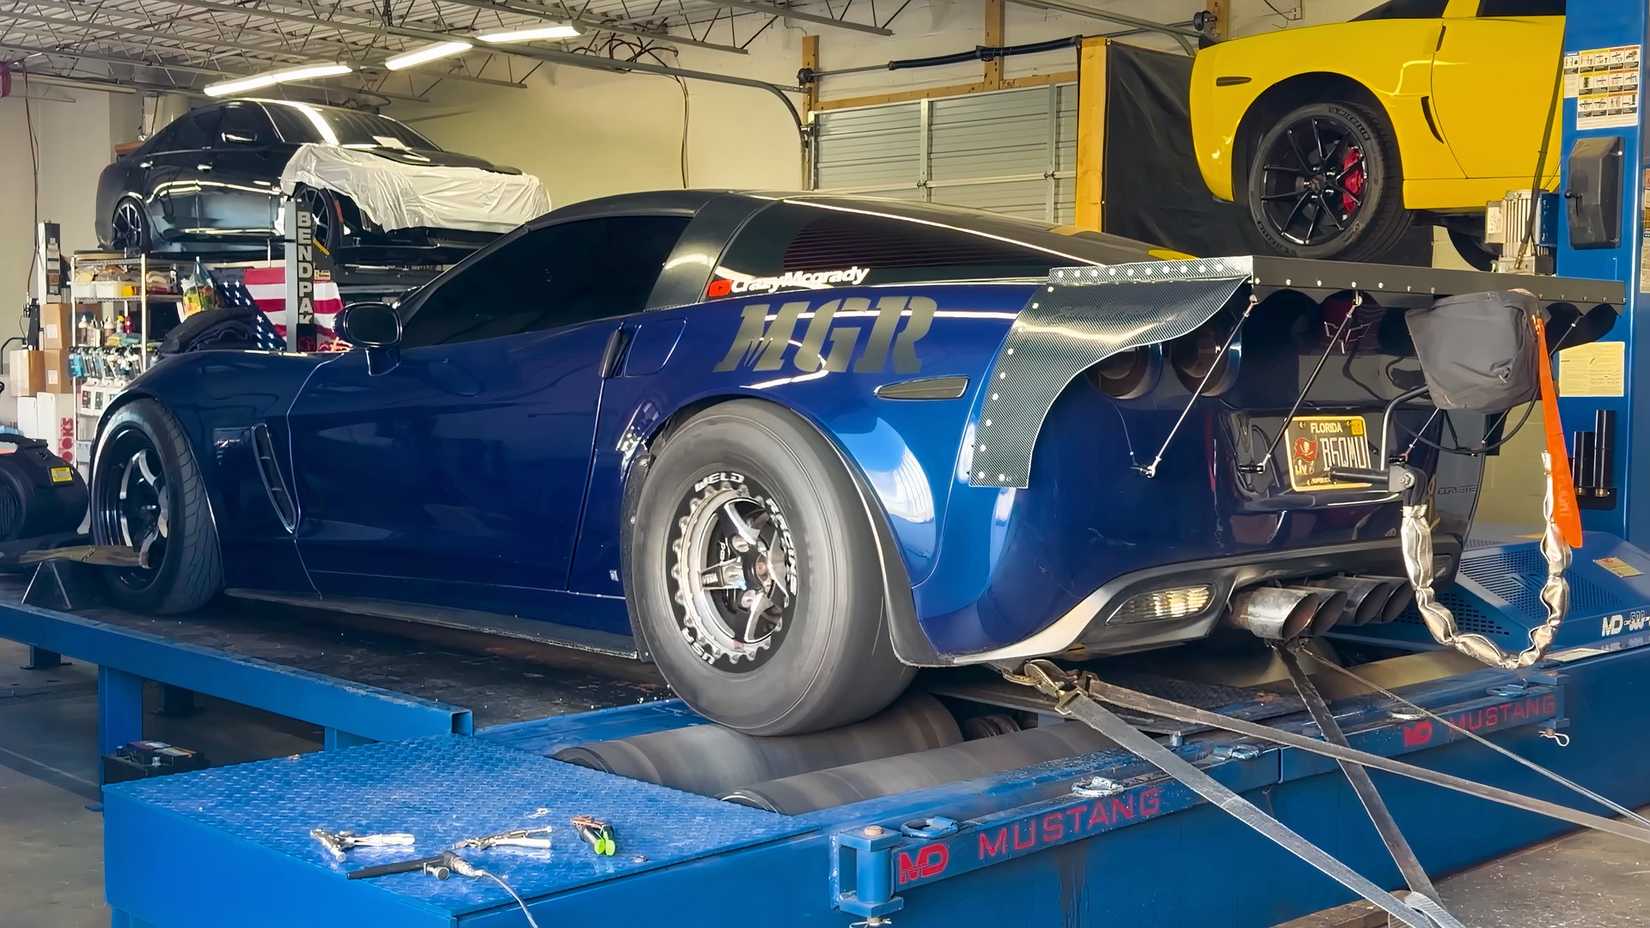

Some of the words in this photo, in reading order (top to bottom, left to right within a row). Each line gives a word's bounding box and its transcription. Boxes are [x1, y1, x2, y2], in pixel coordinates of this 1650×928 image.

[712, 296, 938, 374] MGR
[1310, 422, 1343, 433] FLORIDA
[694, 472, 745, 493] WELD
[977, 786, 1164, 860] MUSTANG
